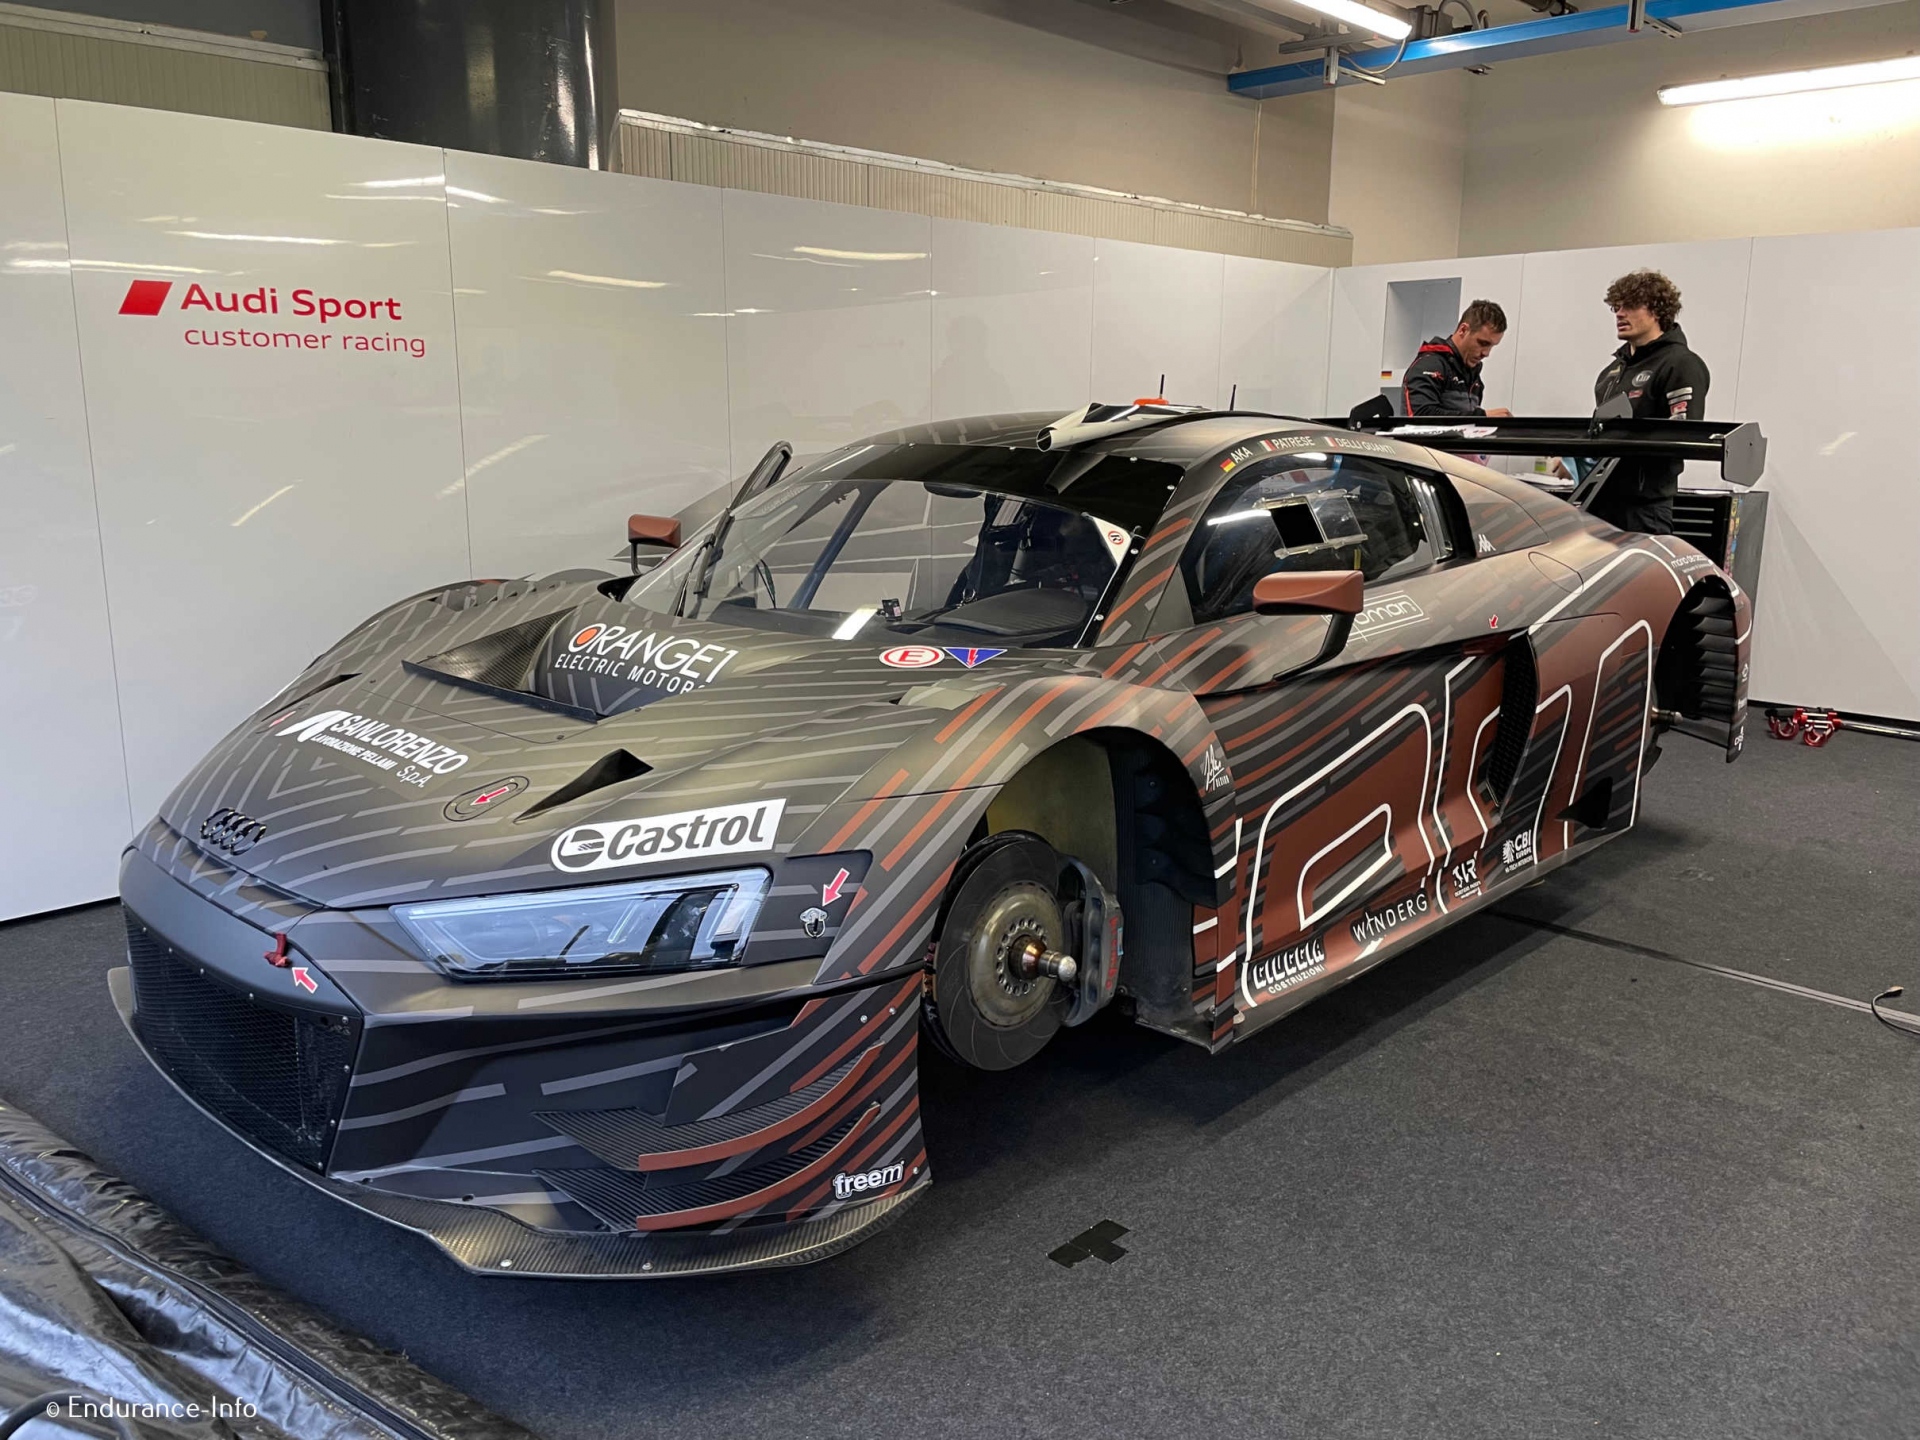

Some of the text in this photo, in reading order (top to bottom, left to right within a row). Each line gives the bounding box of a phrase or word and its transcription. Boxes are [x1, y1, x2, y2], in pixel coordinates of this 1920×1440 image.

[181, 283, 403, 323] Audi Sport
[184, 328, 425, 358] customer racing
[1230, 446, 1253, 464] AKA
[1274, 436, 1315, 450] PATRESE
[1335, 437, 1362, 449] DELLI
[568, 623, 739, 683] ORANGE1
[898, 650, 925, 663] E
[554, 653, 706, 695] ELECTRIC MOTOR
[329, 715, 469, 775] SANLORENZO
[396, 765, 433, 788] S.p.A.
[607, 806, 767, 861] Castrol
[1514, 829, 1532, 852] CBI
[1268, 963, 1325, 994] COSTRUZIONI
[833, 1163, 904, 1197] freem
